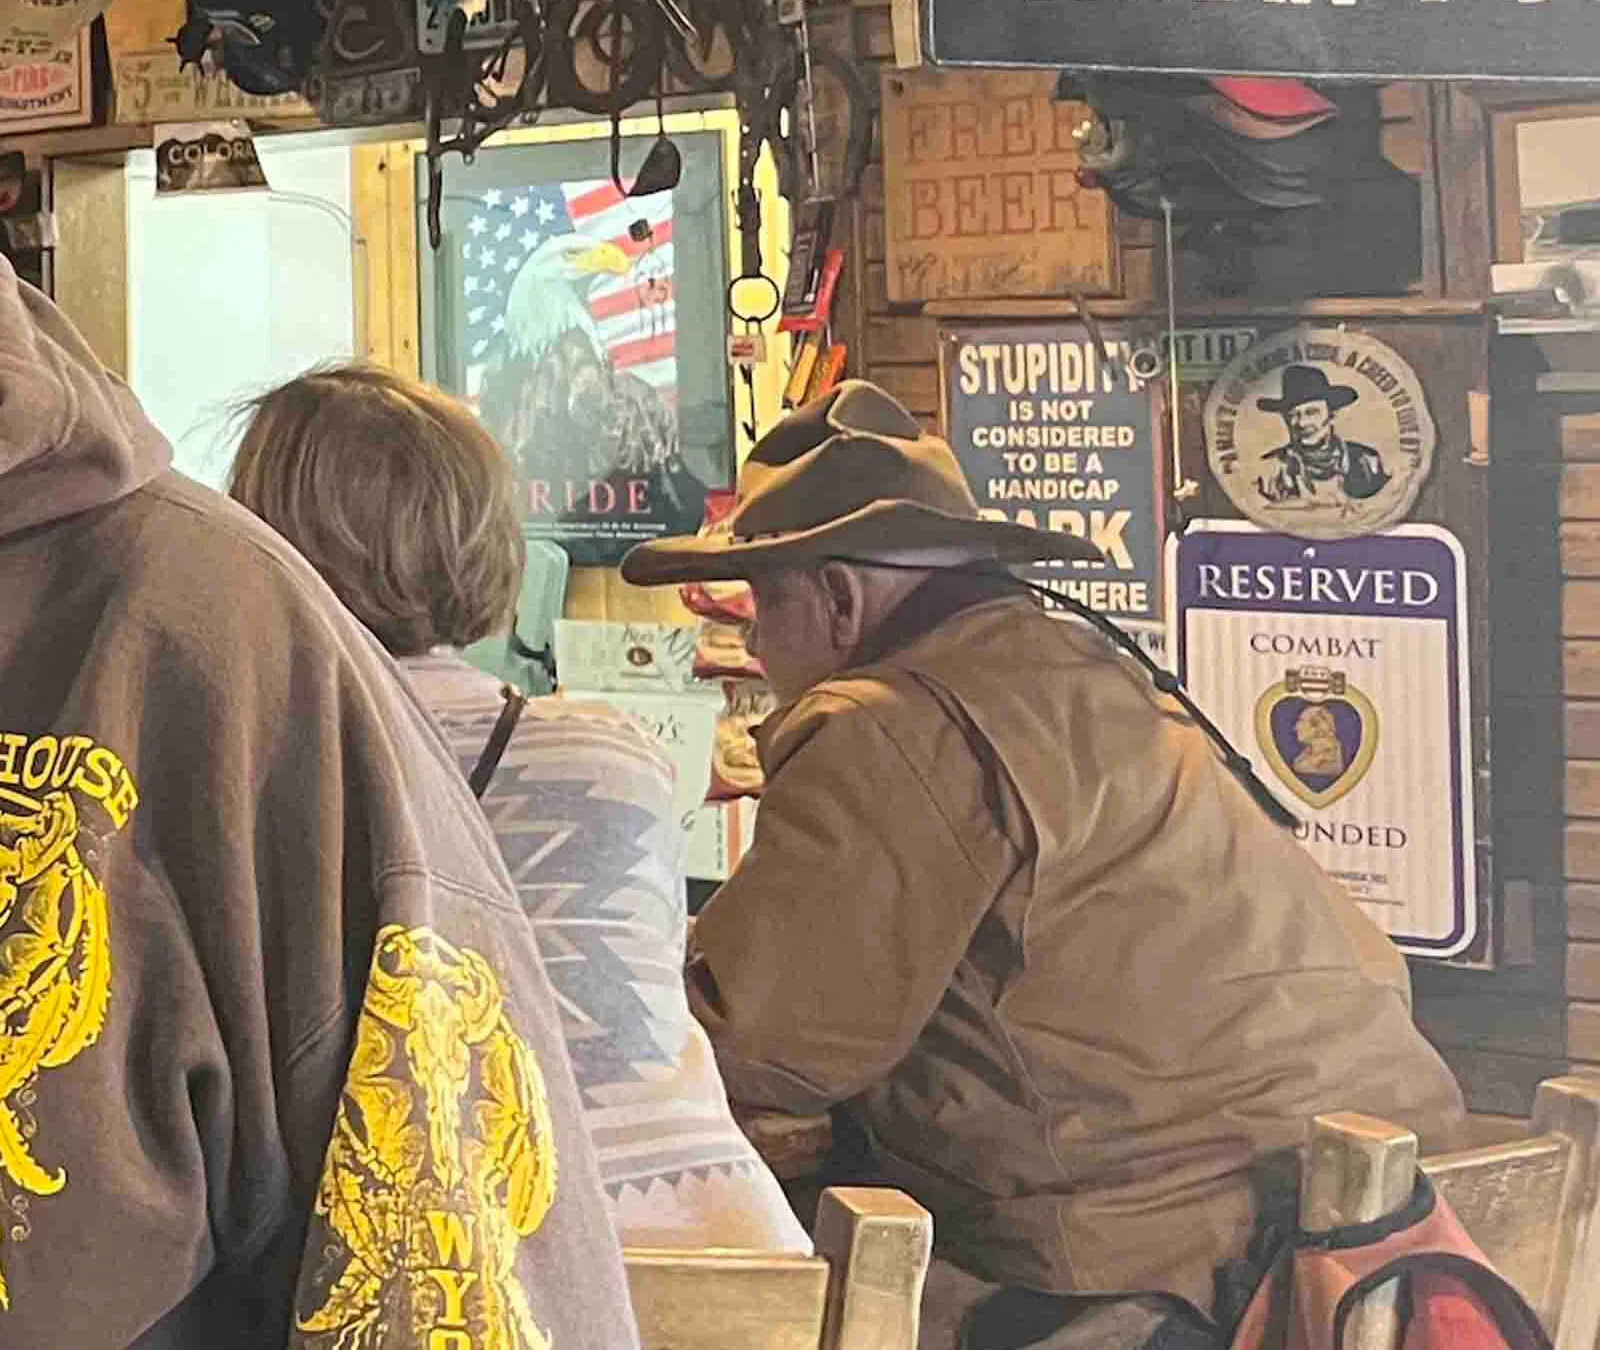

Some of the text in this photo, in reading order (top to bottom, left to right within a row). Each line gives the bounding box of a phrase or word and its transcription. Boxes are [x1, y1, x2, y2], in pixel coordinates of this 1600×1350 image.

[903, 96, 1078, 166] FREE
[903, 168, 1091, 240] BEER
[959, 341, 1140, 395] STUPIDITY
[1009, 400, 1094, 421] IS NOT
[971, 426, 1135, 448] CONSIDERED
[1003, 452, 1104, 474] TO BE A
[512, 477, 653, 515] RIDE
[987, 479, 1121, 501] HANDICAP
[1030, 579, 1149, 613] WHERE
[1197, 564, 1439, 609] RESERVED
[1248, 633, 1381, 660] COMBAT
[1290, 819, 1408, 850] UNDED
